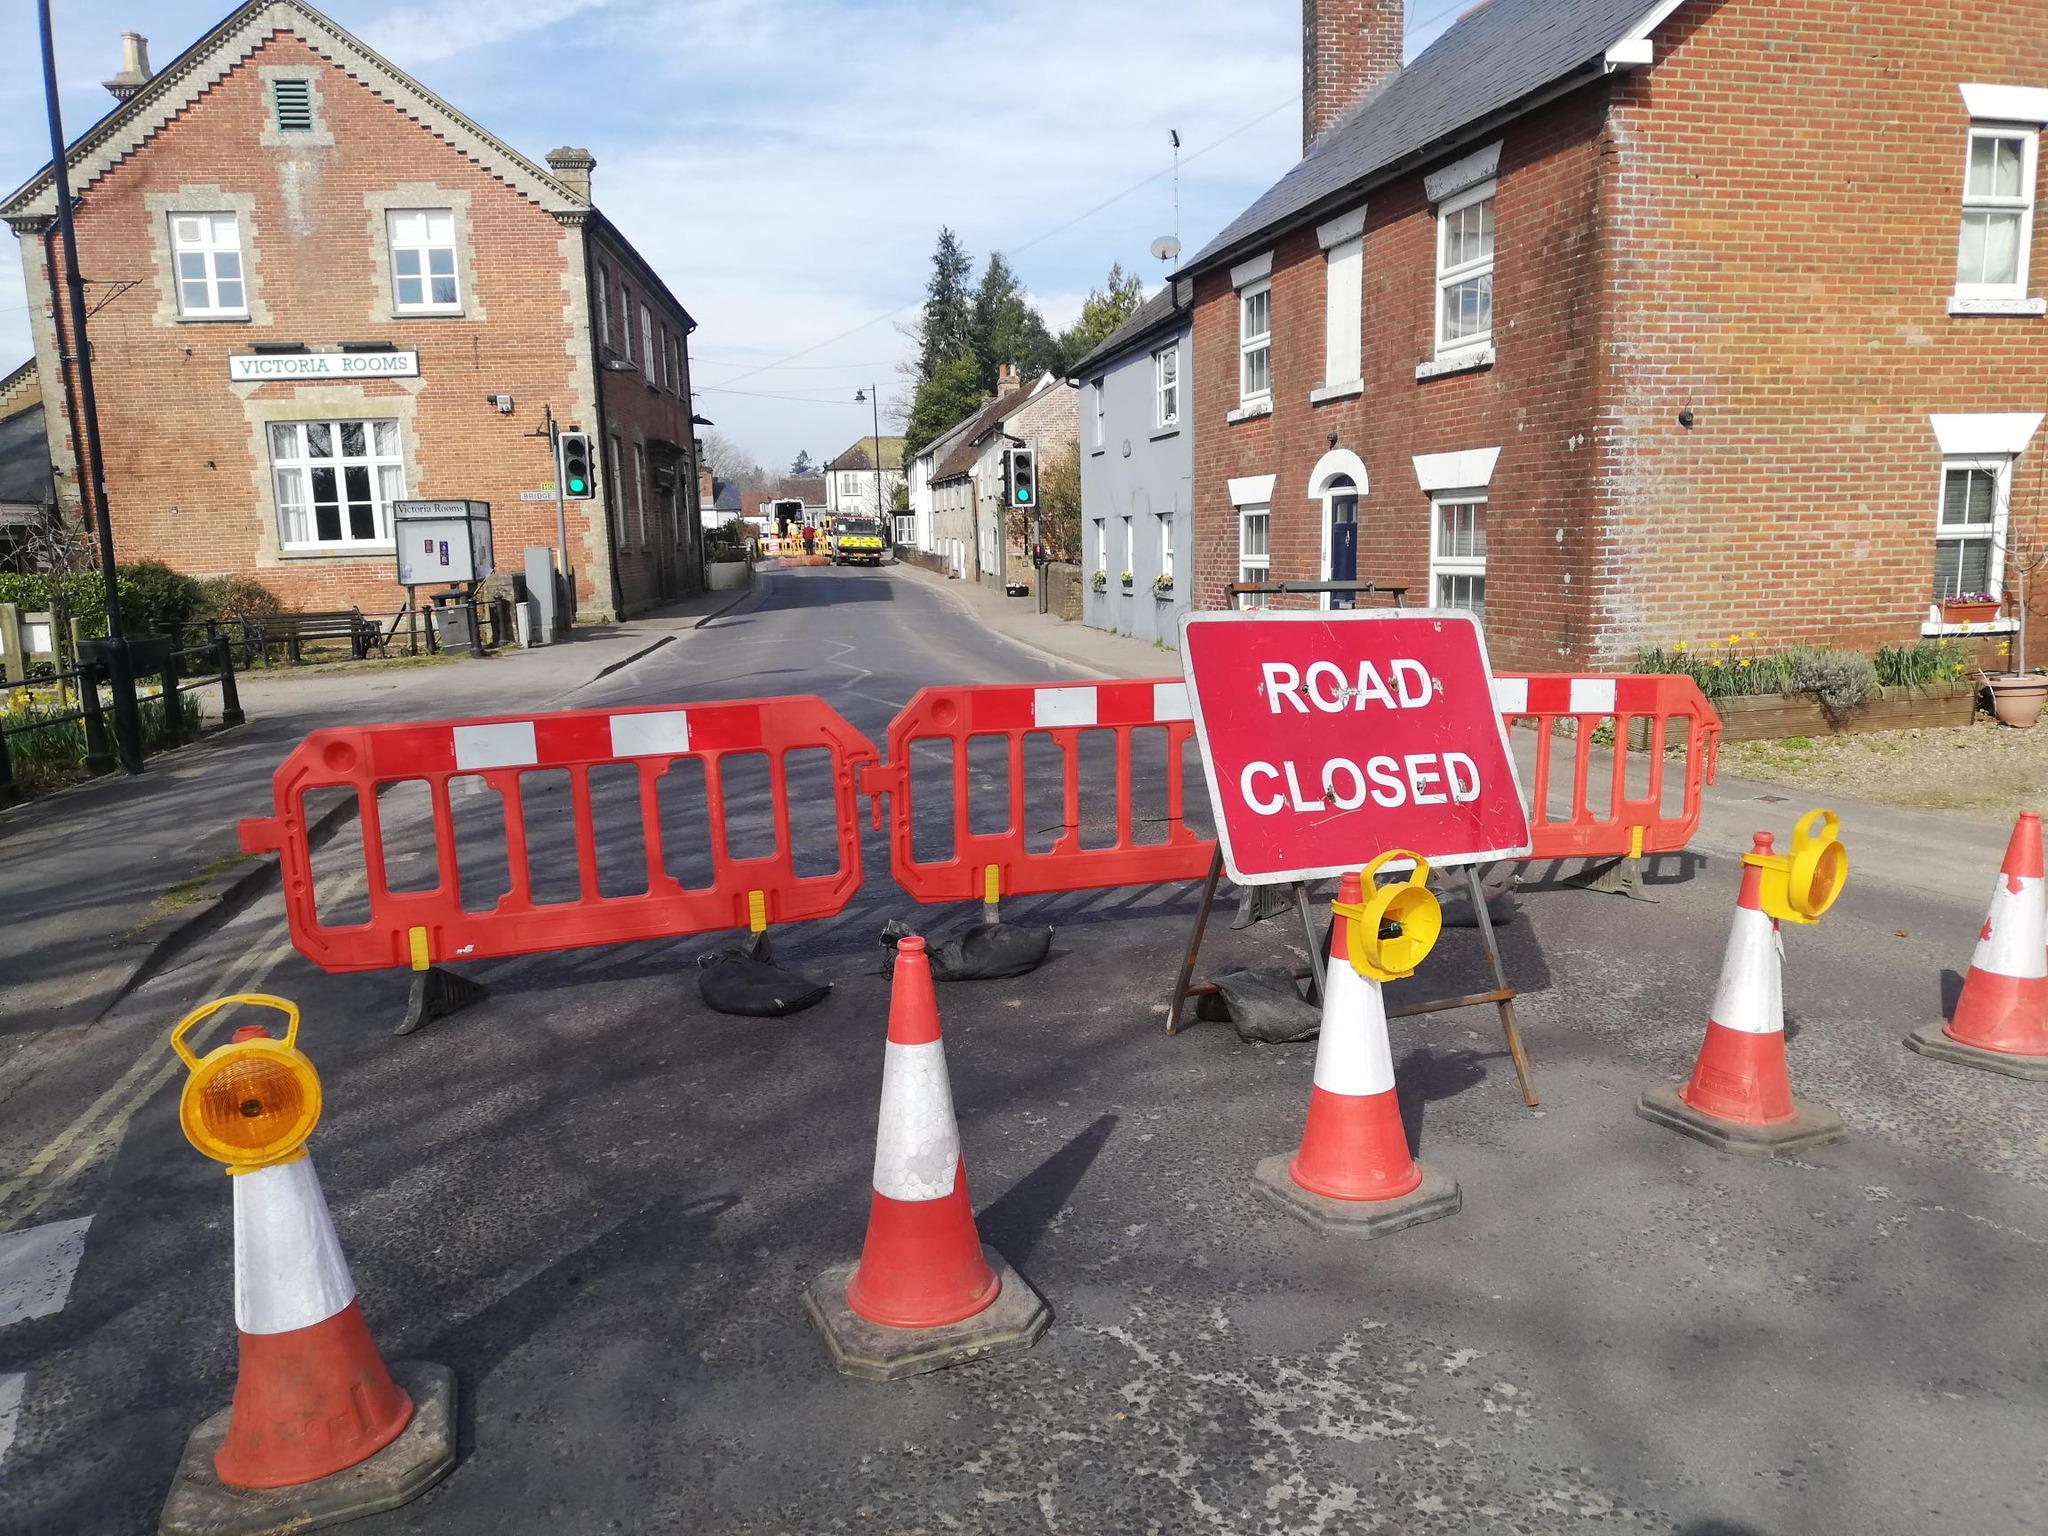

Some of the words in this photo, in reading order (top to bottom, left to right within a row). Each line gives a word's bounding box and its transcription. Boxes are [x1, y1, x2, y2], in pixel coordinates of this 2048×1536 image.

[239, 358, 330, 374] VICTORIA
[342, 356, 408, 372] ROOMS
[397, 503, 431, 513] Victoria
[434, 503, 463, 513] Rooms
[1261, 658, 1434, 714] ROAD
[1240, 752, 1482, 816] CLOSED
